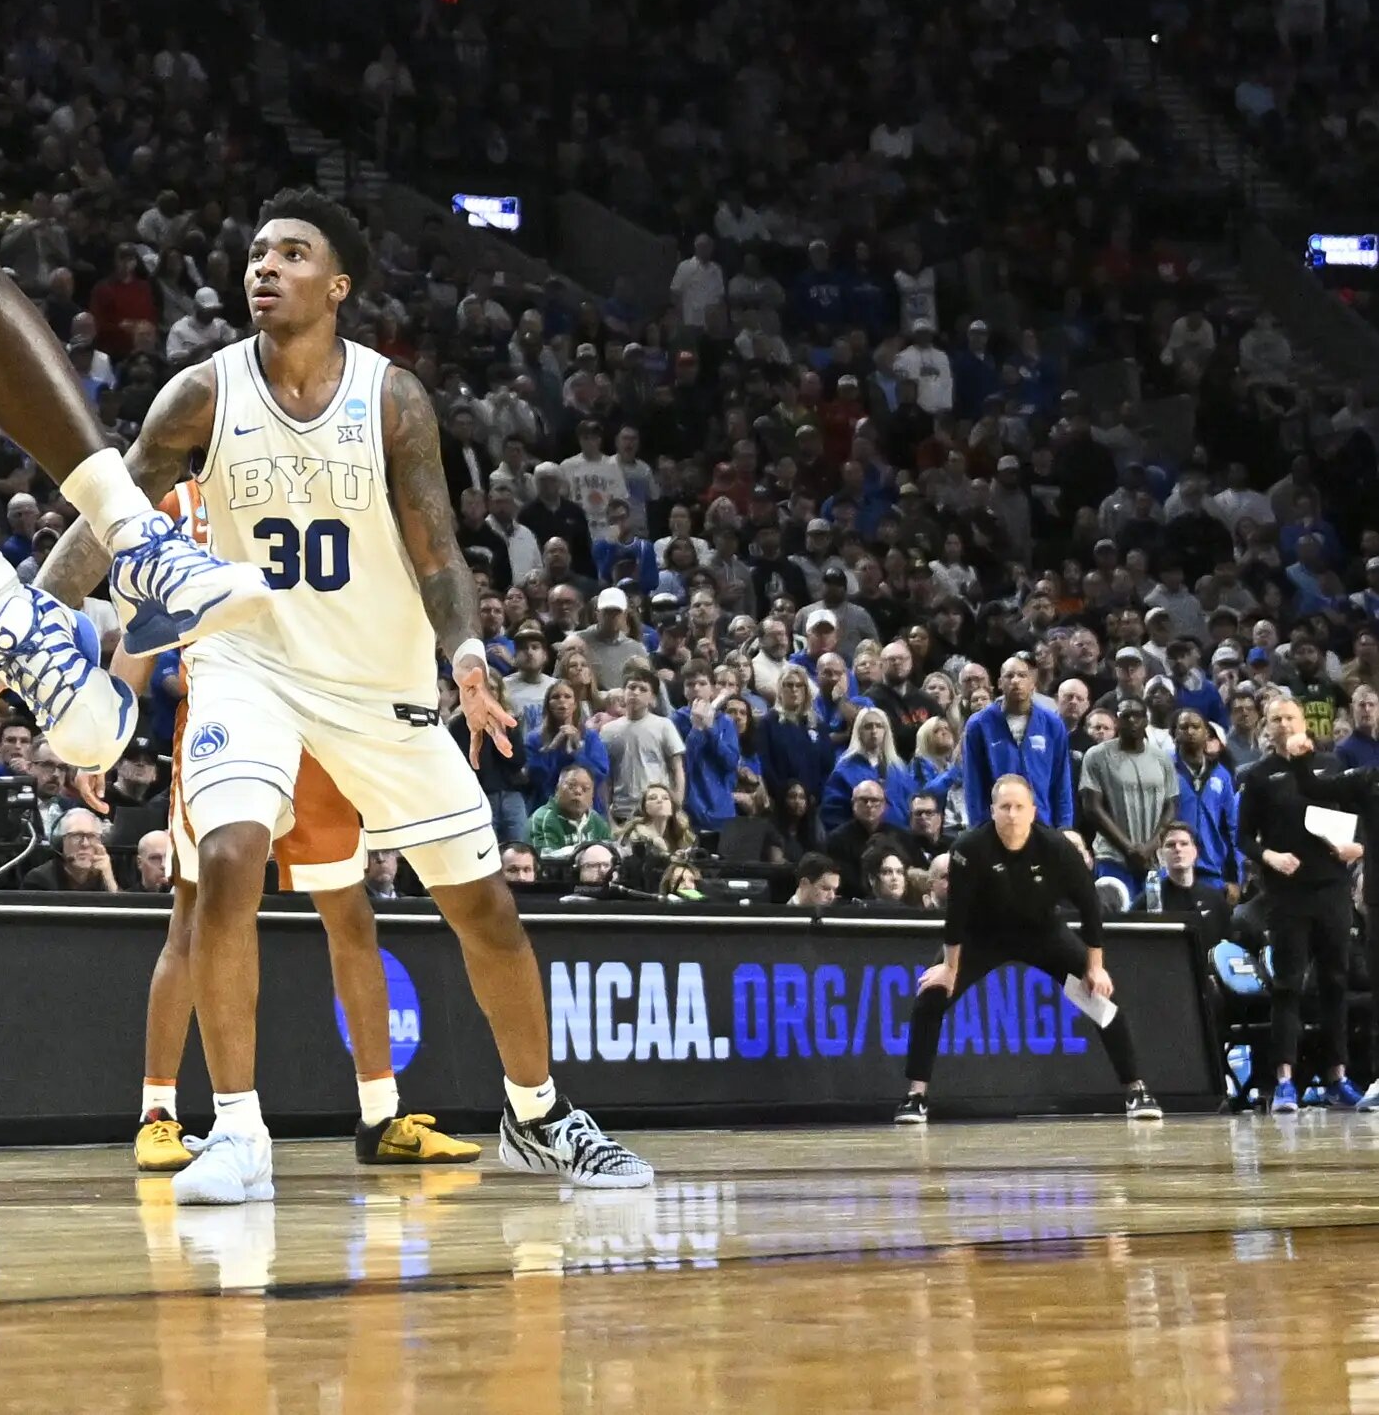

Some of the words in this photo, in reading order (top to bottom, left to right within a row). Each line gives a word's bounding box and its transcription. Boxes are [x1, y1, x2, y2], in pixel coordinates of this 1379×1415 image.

[229, 455, 374, 512] BYU
[252, 516, 351, 593] 30
[550, 961, 1087, 1061] NCAA.ORG/CANGE
